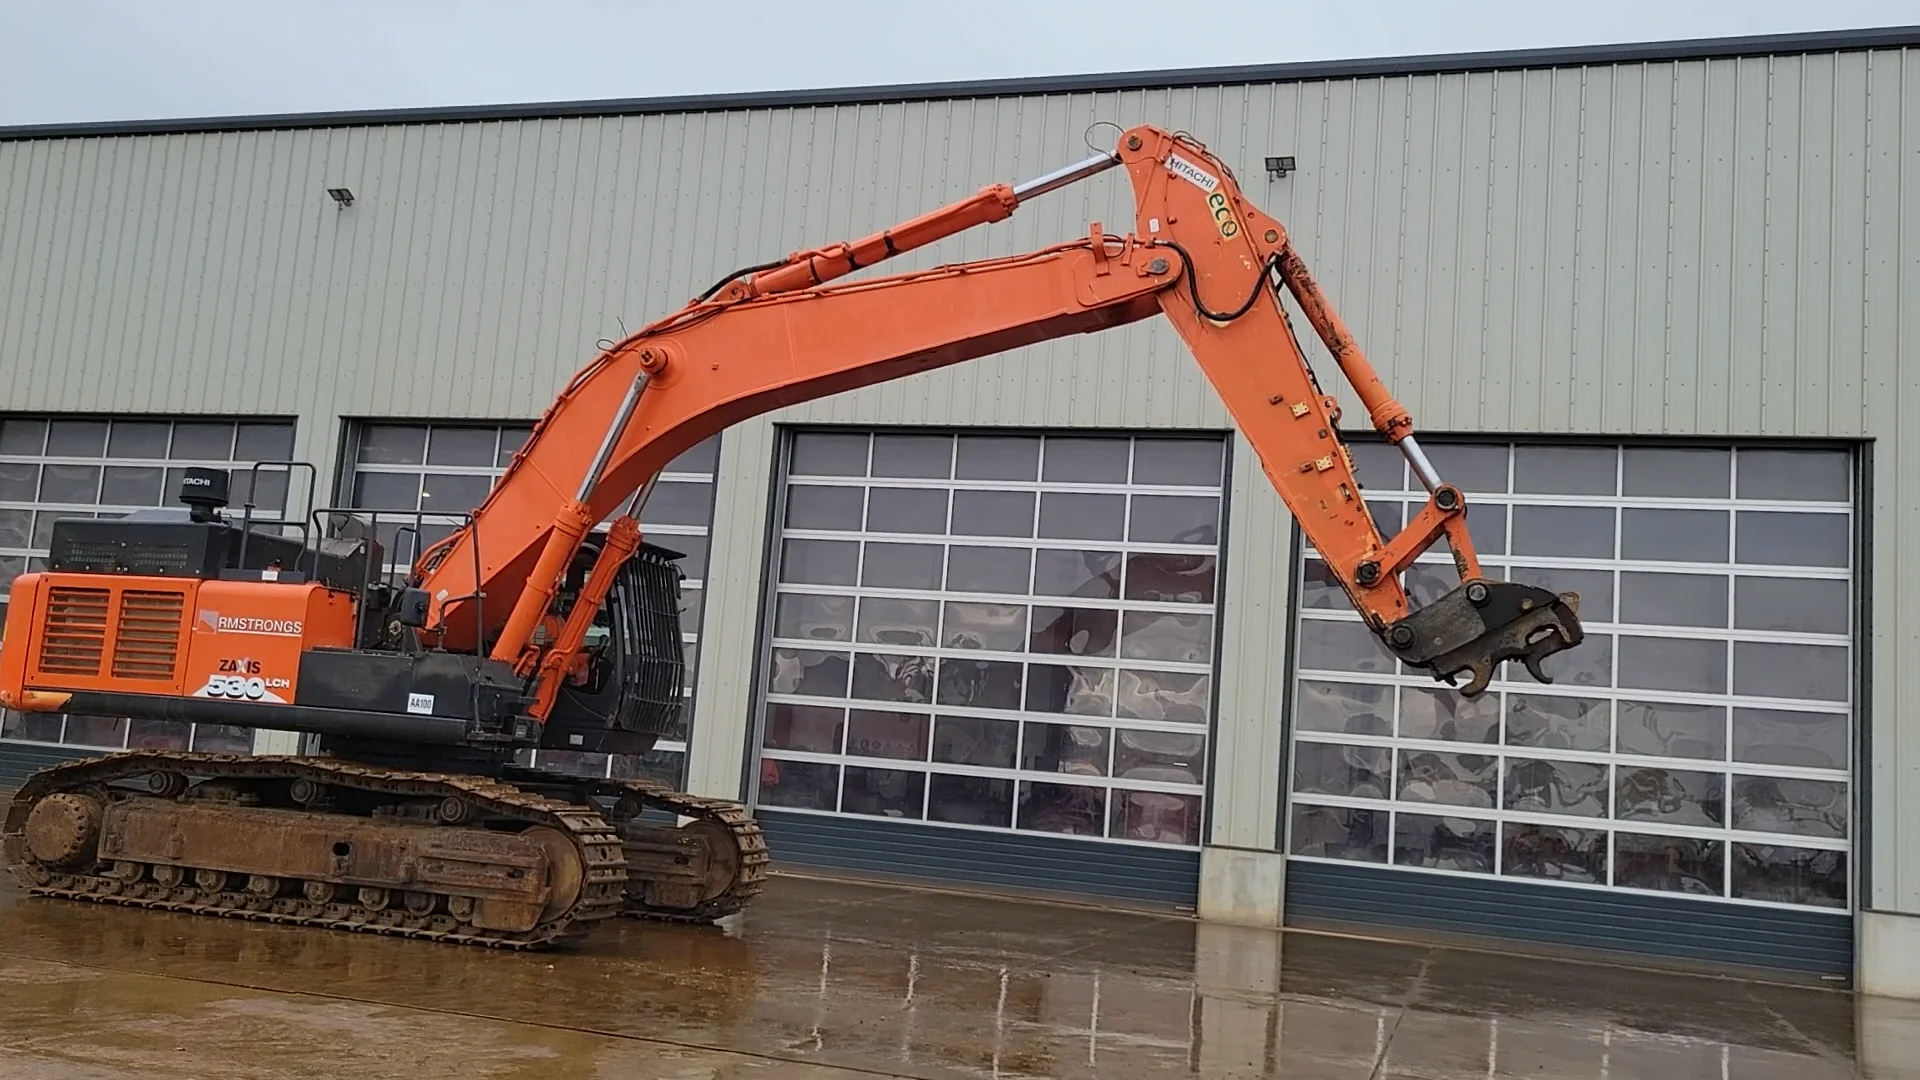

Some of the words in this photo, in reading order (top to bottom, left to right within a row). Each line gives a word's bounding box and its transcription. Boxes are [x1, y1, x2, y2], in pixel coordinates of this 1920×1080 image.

[1169, 157, 1215, 189] HITACHI
[1208, 193, 1238, 237] eco
[182, 477, 211, 486] ITACHI
[218, 657, 261, 674] ZAXIS
[206, 674, 265, 699] 530
[265, 678, 291, 689] LCH
[410, 698, 432, 710] AA100
